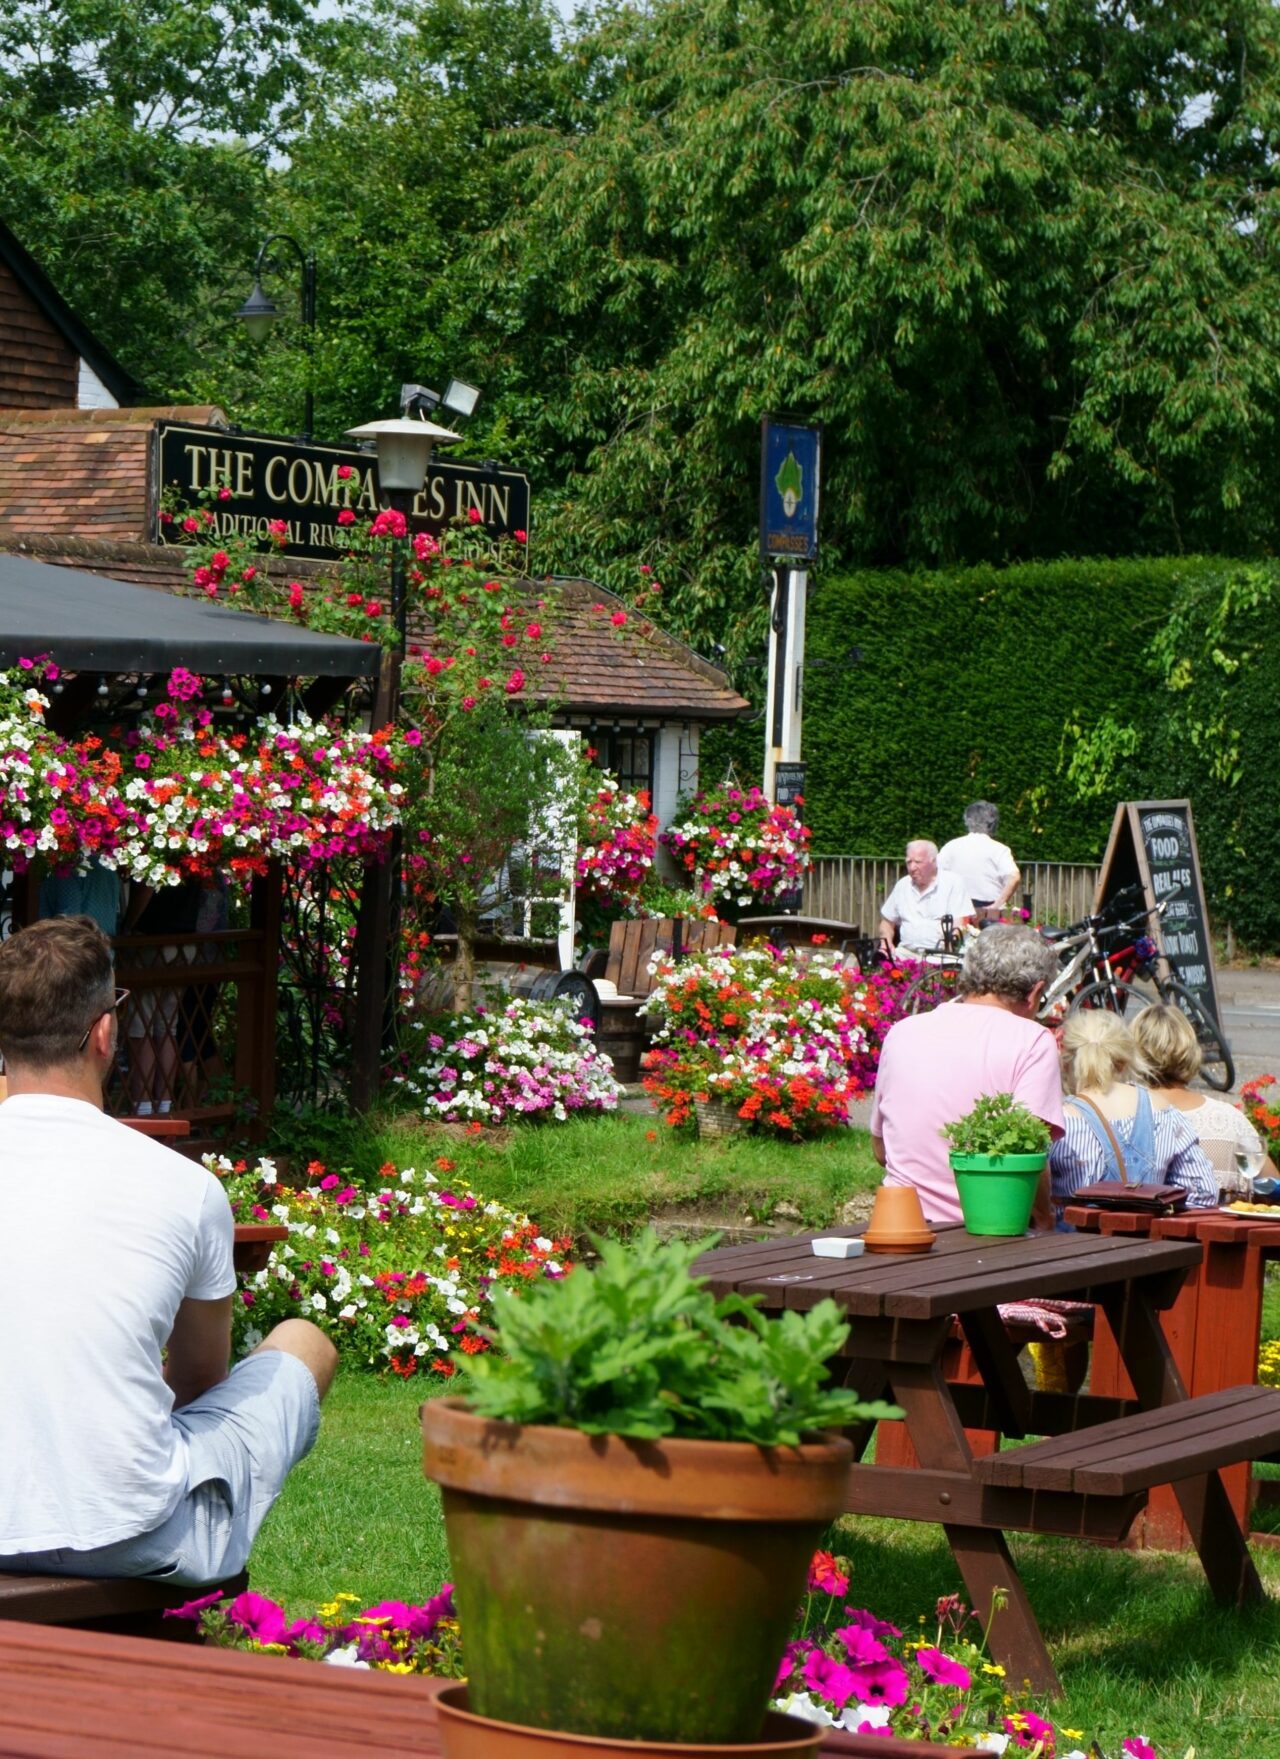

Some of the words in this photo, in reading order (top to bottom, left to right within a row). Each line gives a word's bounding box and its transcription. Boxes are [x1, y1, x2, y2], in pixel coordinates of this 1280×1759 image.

[184, 445, 254, 497] THE
[265, 456, 445, 519] COMPAES
[455, 479, 510, 526] INN
[206, 511, 304, 544] ADITIOAL
[1151, 837, 1179, 859] FOOD
[1153, 871, 1173, 896] REAL
